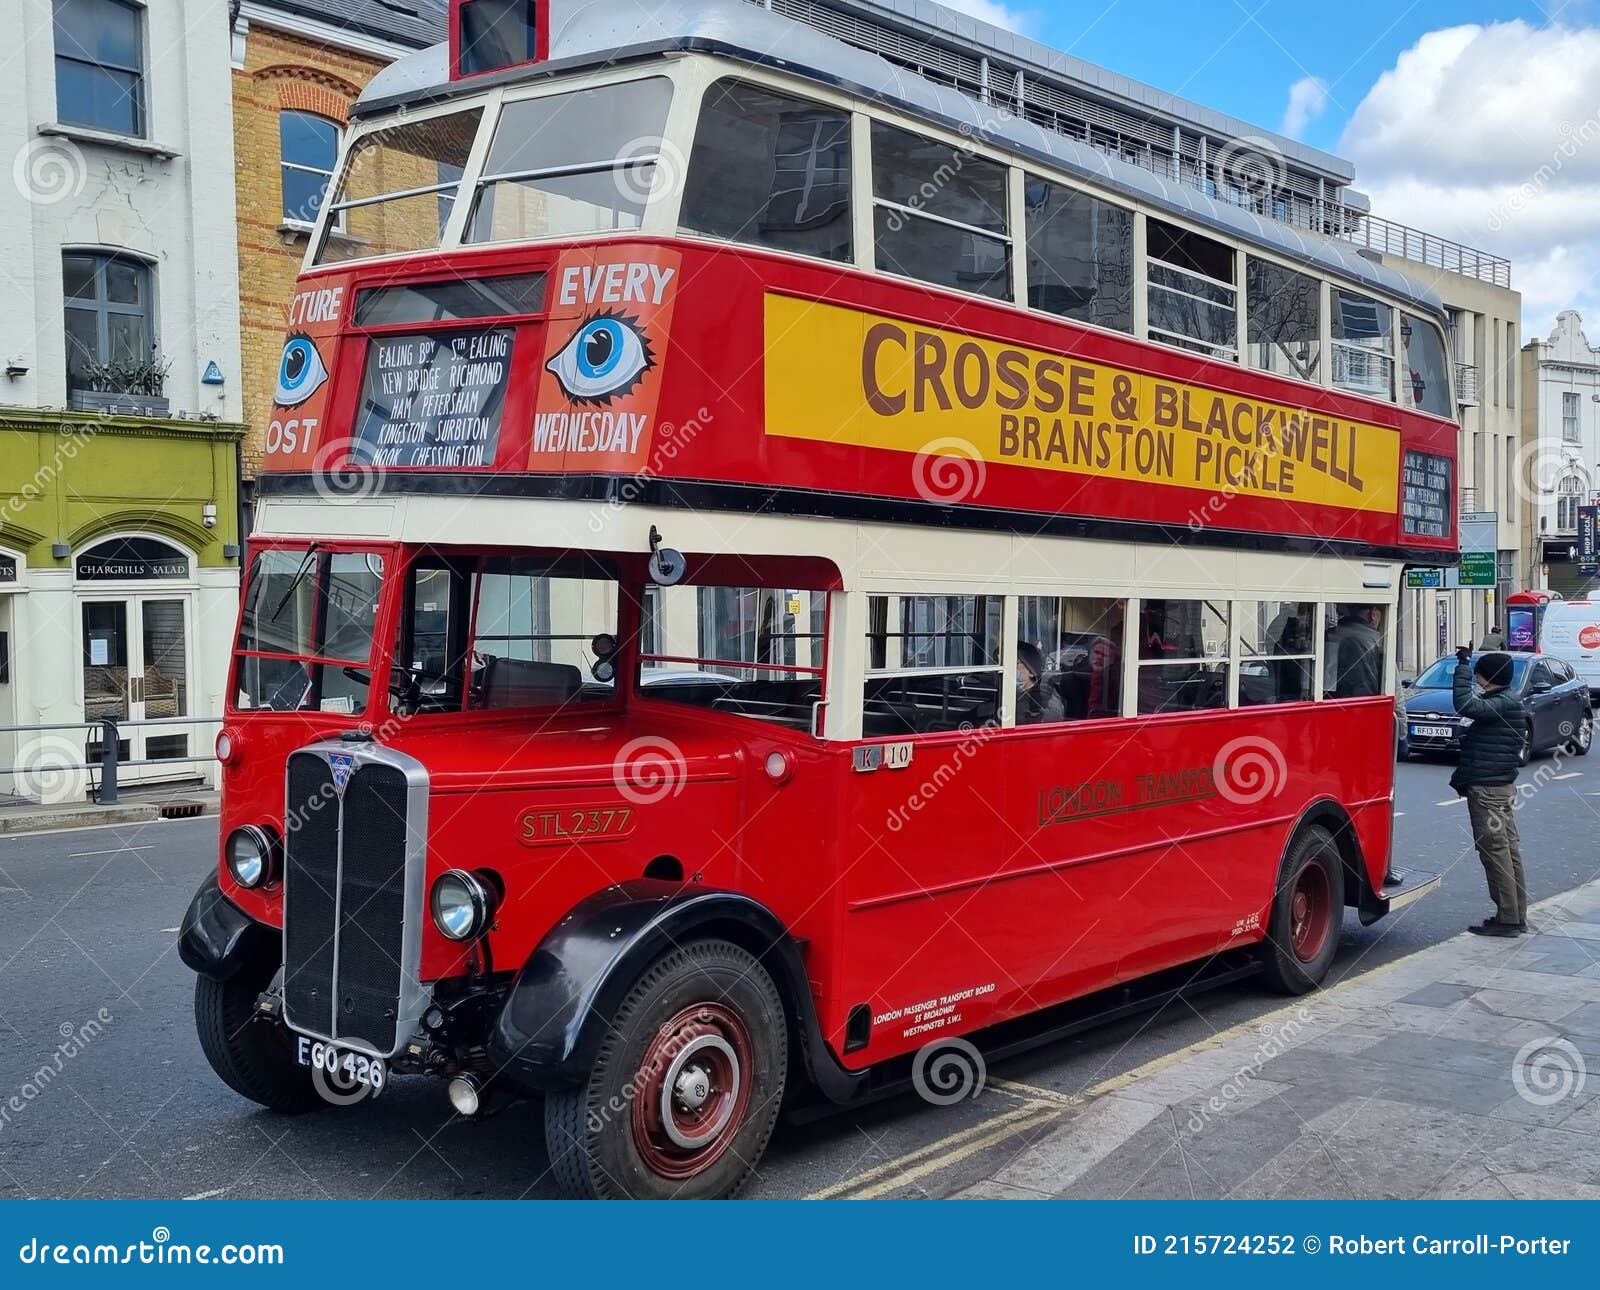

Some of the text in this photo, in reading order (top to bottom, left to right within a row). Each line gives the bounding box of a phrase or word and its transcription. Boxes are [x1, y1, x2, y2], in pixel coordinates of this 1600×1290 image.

[560, 263, 675, 305] EVERY
[378, 344, 413, 369] EALING
[469, 334, 508, 360] EALING
[382, 362, 503, 395] KEW BRIDGE RICHMOND
[390, 390, 479, 420] HAM PETERSHAM
[862, 323, 1364, 493] CROSSE & BLACKWELL
[266, 418, 318, 454] OST
[377, 417, 490, 445] KINGSTON SURBITON
[534, 412, 647, 454] WEDNESDAY
[371, 445, 484, 466] HOOK CHESSINGTON
[1001, 415, 1294, 493] BRANSTON PICKLE
[79, 565, 186, 575] CHARGRILLS SALAD
[862, 746, 908, 767] K 10
[1038, 763, 1231, 826] LONDON TRANSPO
[873, 983, 995, 1025] LONDON PASSENGER TRANSPORT BOARD
[923, 1005, 956, 1020] BROADWAY
[903, 1018, 945, 1038] WESTMINSTER
[298, 1036, 382, 1088] EGO 426
